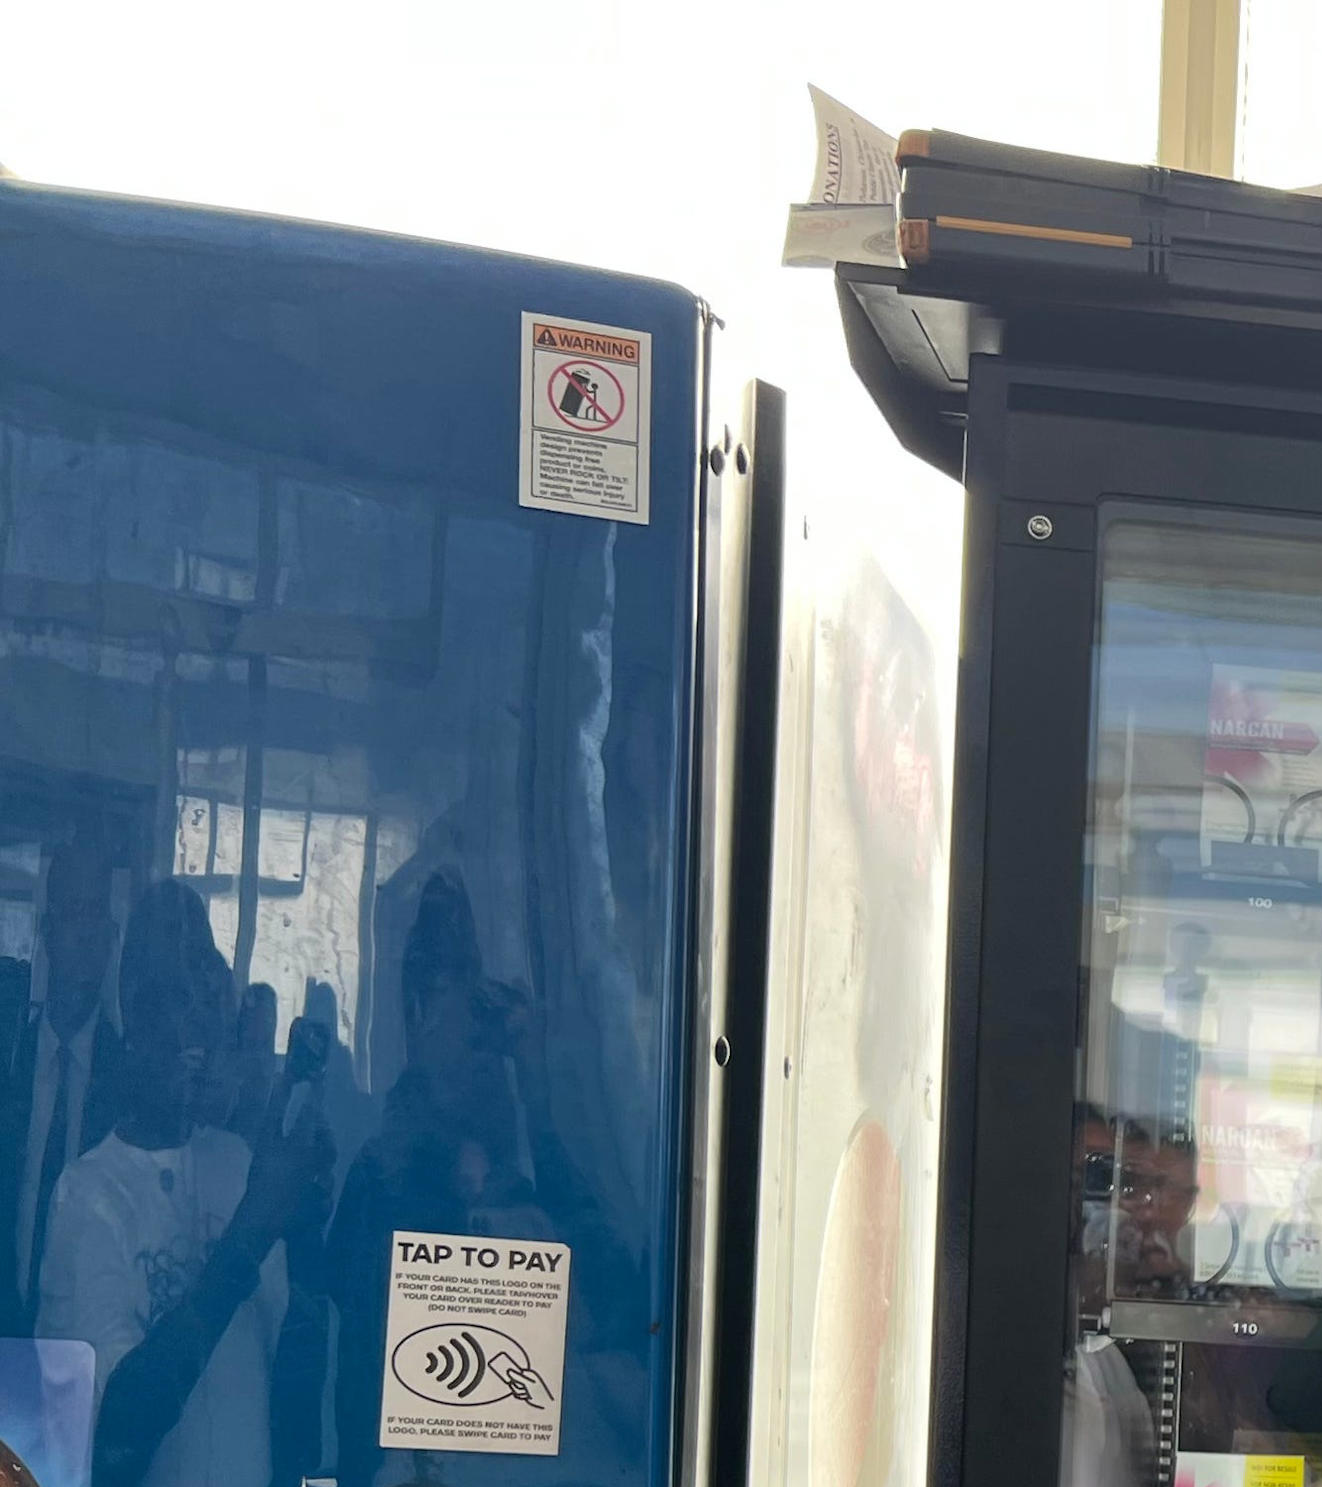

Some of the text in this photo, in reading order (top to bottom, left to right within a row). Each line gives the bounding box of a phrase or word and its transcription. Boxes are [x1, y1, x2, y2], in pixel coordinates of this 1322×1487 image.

[823, 122, 839, 204] ONATIONS
[559, 333, 635, 359] WARNING
[1209, 718, 1285, 740] NARCAN
[398, 1242, 563, 1272] TAP TO PAY
[405, 1273, 431, 1281] YOUR
[432, 1275, 459, 1283] CARD
[460, 1277, 479, 1285] HAS
[502, 1280, 528, 1288] LOGO
[474, 1288, 506, 1296] PLEASE
[430, 1294, 456, 1302] CARD
[484, 1298, 520, 1306] READER
[428, 1303, 445, 1312] (DO
[498, 1309, 527, 1318] CARD)
[1232, 1322, 1258, 1335] 110
[427, 1418, 454, 1426] CARD
[485, 1421, 504, 1429] NOT
[420, 1428, 455, 1436] PLEASE
[458, 1430, 487, 1438] SWIPE
[490, 1431, 517, 1439] CARD
